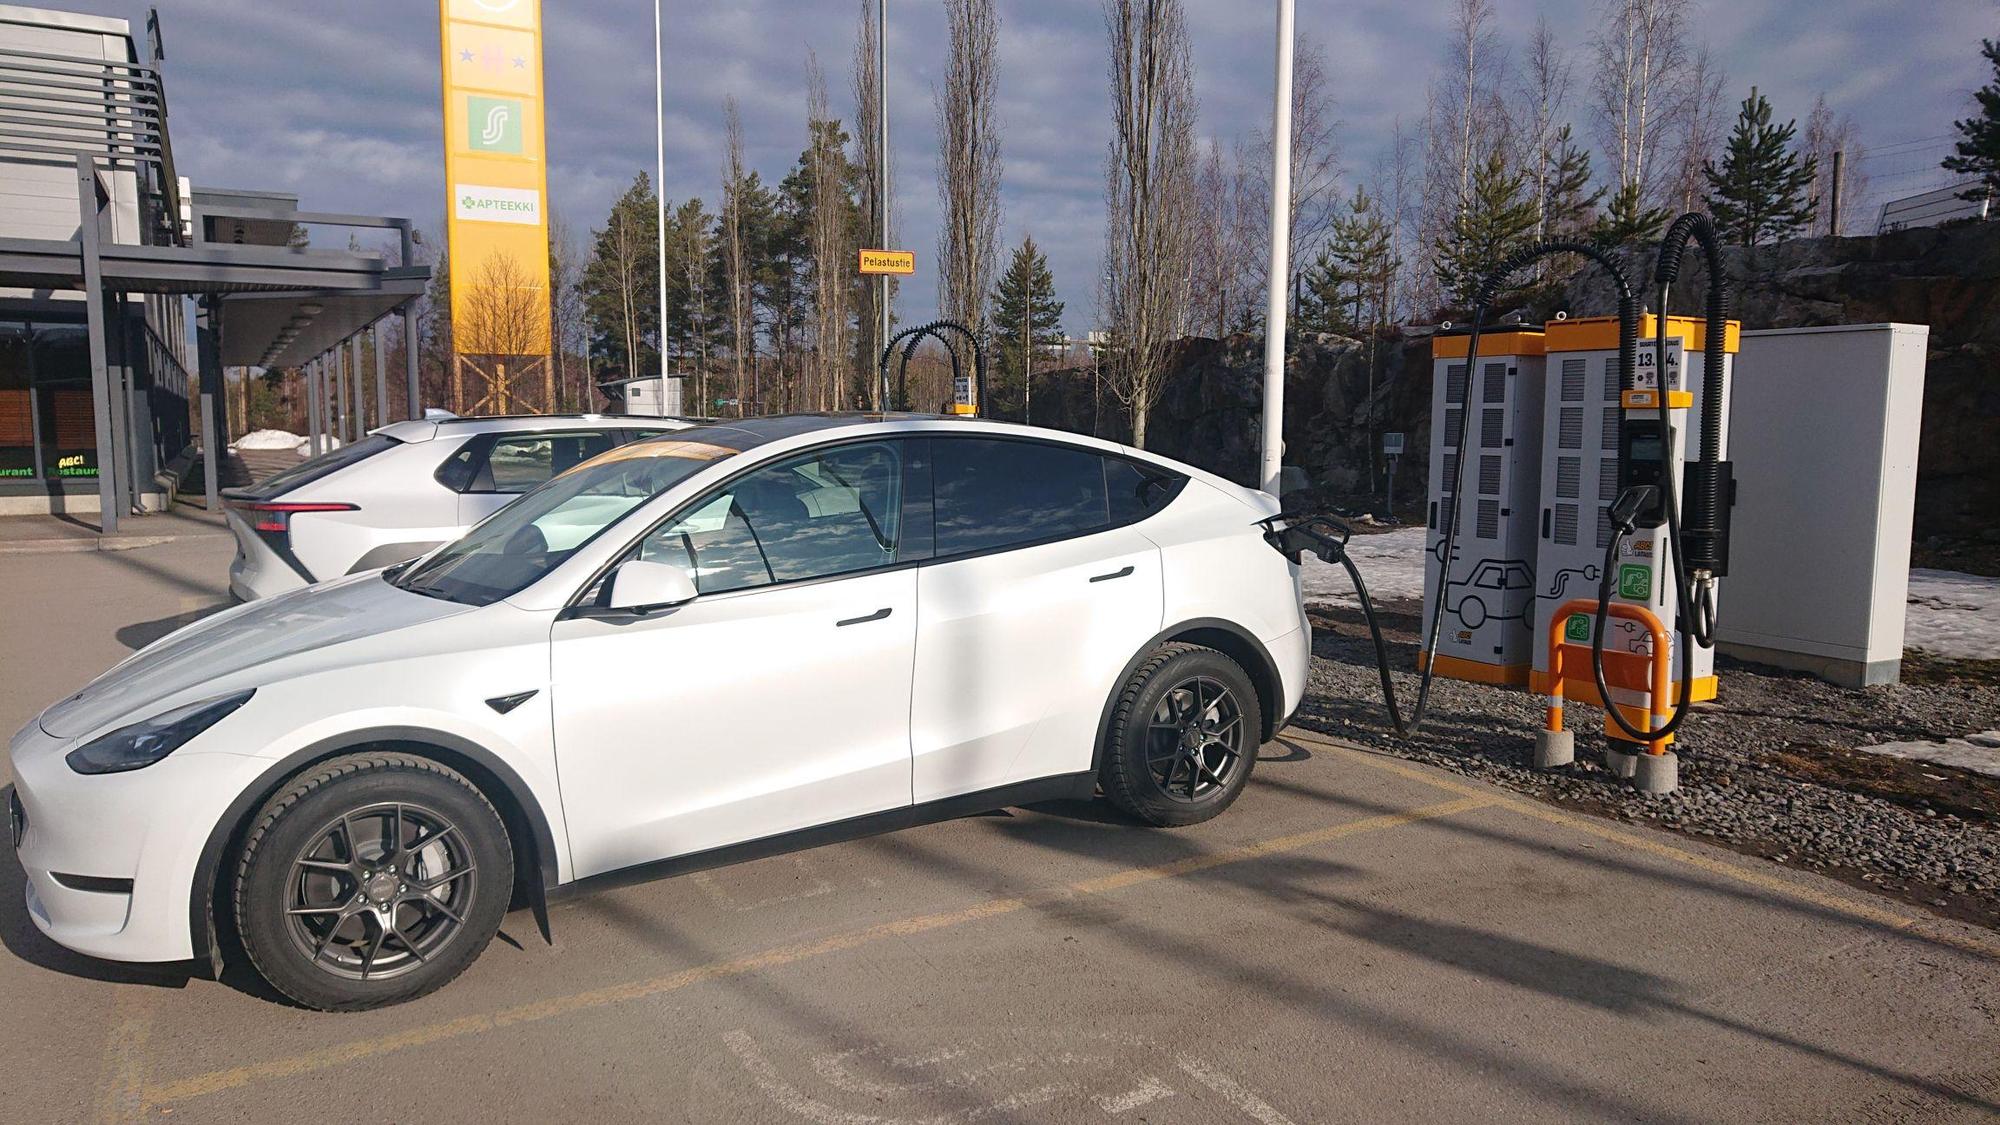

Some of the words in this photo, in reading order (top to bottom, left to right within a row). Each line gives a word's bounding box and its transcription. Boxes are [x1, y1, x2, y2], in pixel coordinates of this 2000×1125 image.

[477, 199, 534, 212] APTEEKKI
[863, 256, 911, 268] Pelastustie
[1637, 352, 1656, 367] 13.
